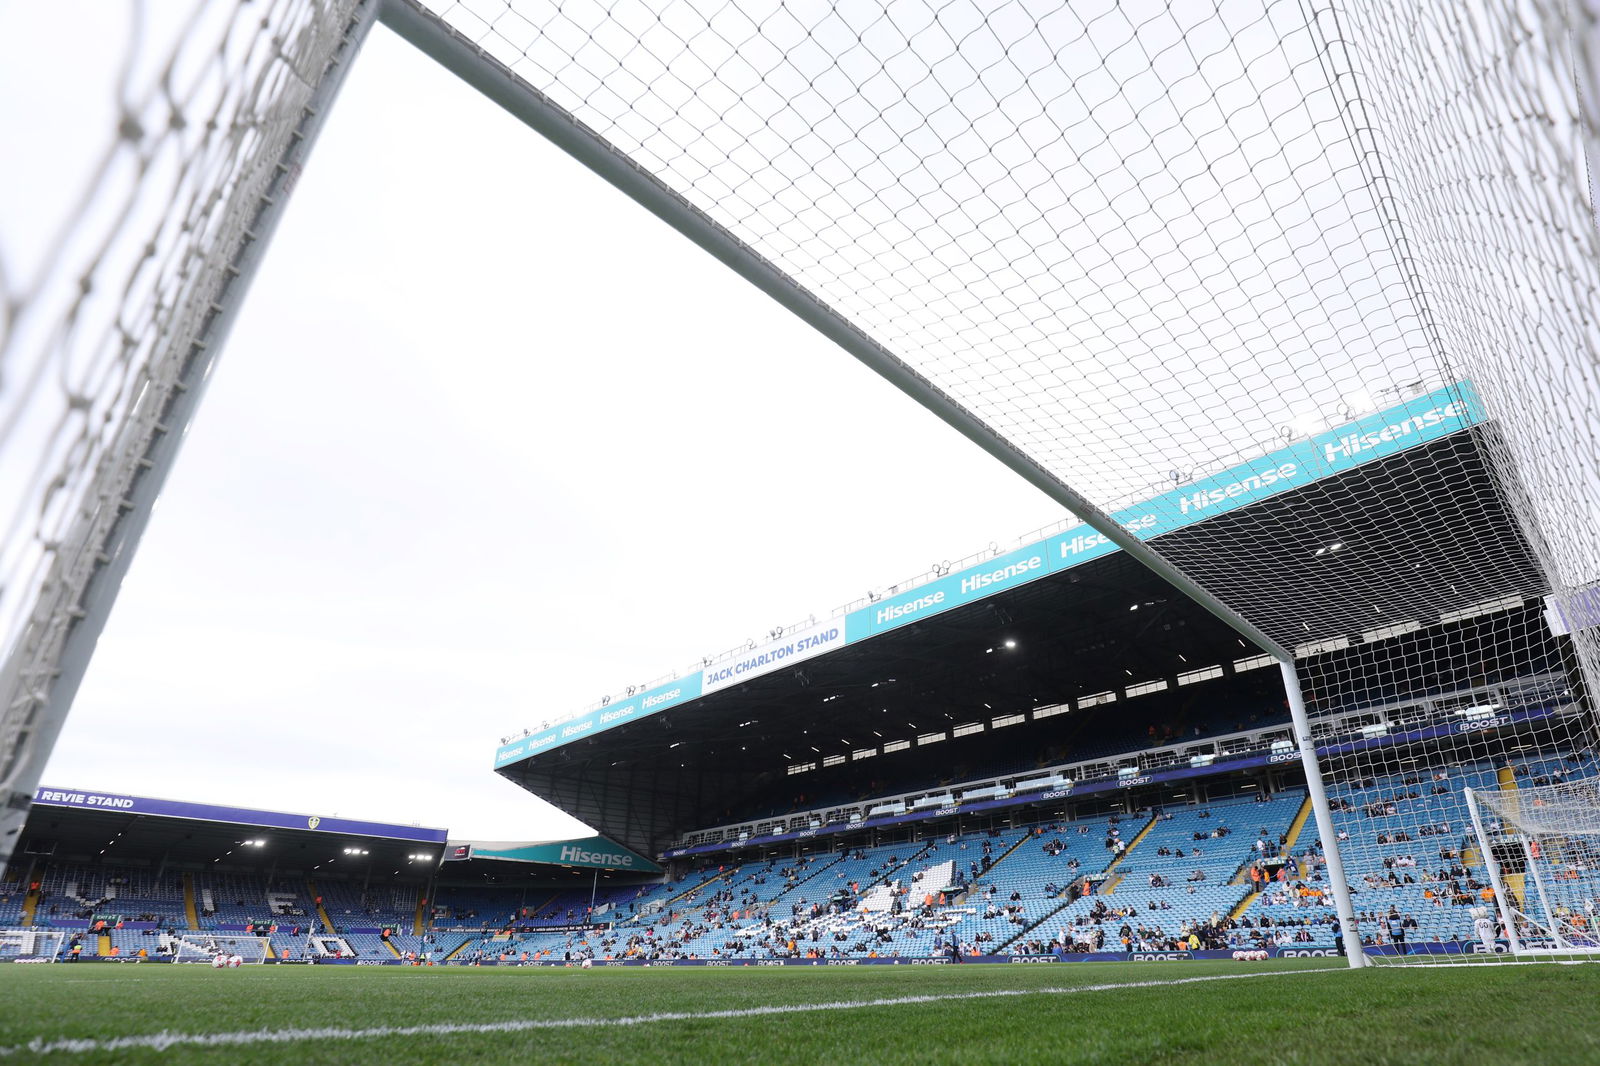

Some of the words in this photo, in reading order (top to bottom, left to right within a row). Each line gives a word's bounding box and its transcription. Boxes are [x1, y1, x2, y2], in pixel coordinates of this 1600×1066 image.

[1324, 401, 1468, 462] Hisense
[1180, 463, 1297, 514] Hisense
[1061, 514, 1157, 558] Hisese
[961, 556, 1042, 594] Hisense
[876, 591, 945, 624] Hisense
[707, 666, 733, 685] JACK
[735, 644, 794, 674] CHARLTON
[797, 628, 839, 652] STAND
[642, 688, 681, 709] Hisense
[600, 705, 634, 724] Hisense
[1460, 716, 1508, 731] BOOST
[561, 720, 592, 738] Hisense
[528, 734, 556, 750] Hisense
[498, 746, 524, 761] Hisense
[1270, 753, 1302, 763] BOOS
[1119, 777, 1150, 787] BOOST
[41, 790, 86, 804] REVIE
[86, 795, 134, 808] STAND
[1043, 789, 1070, 799] BOOST
[935, 807, 959, 816] BOOST
[560, 845, 633, 867] Hisense
[1012, 955, 1056, 963] BOOST
[1283, 949, 1339, 958] BOOS
